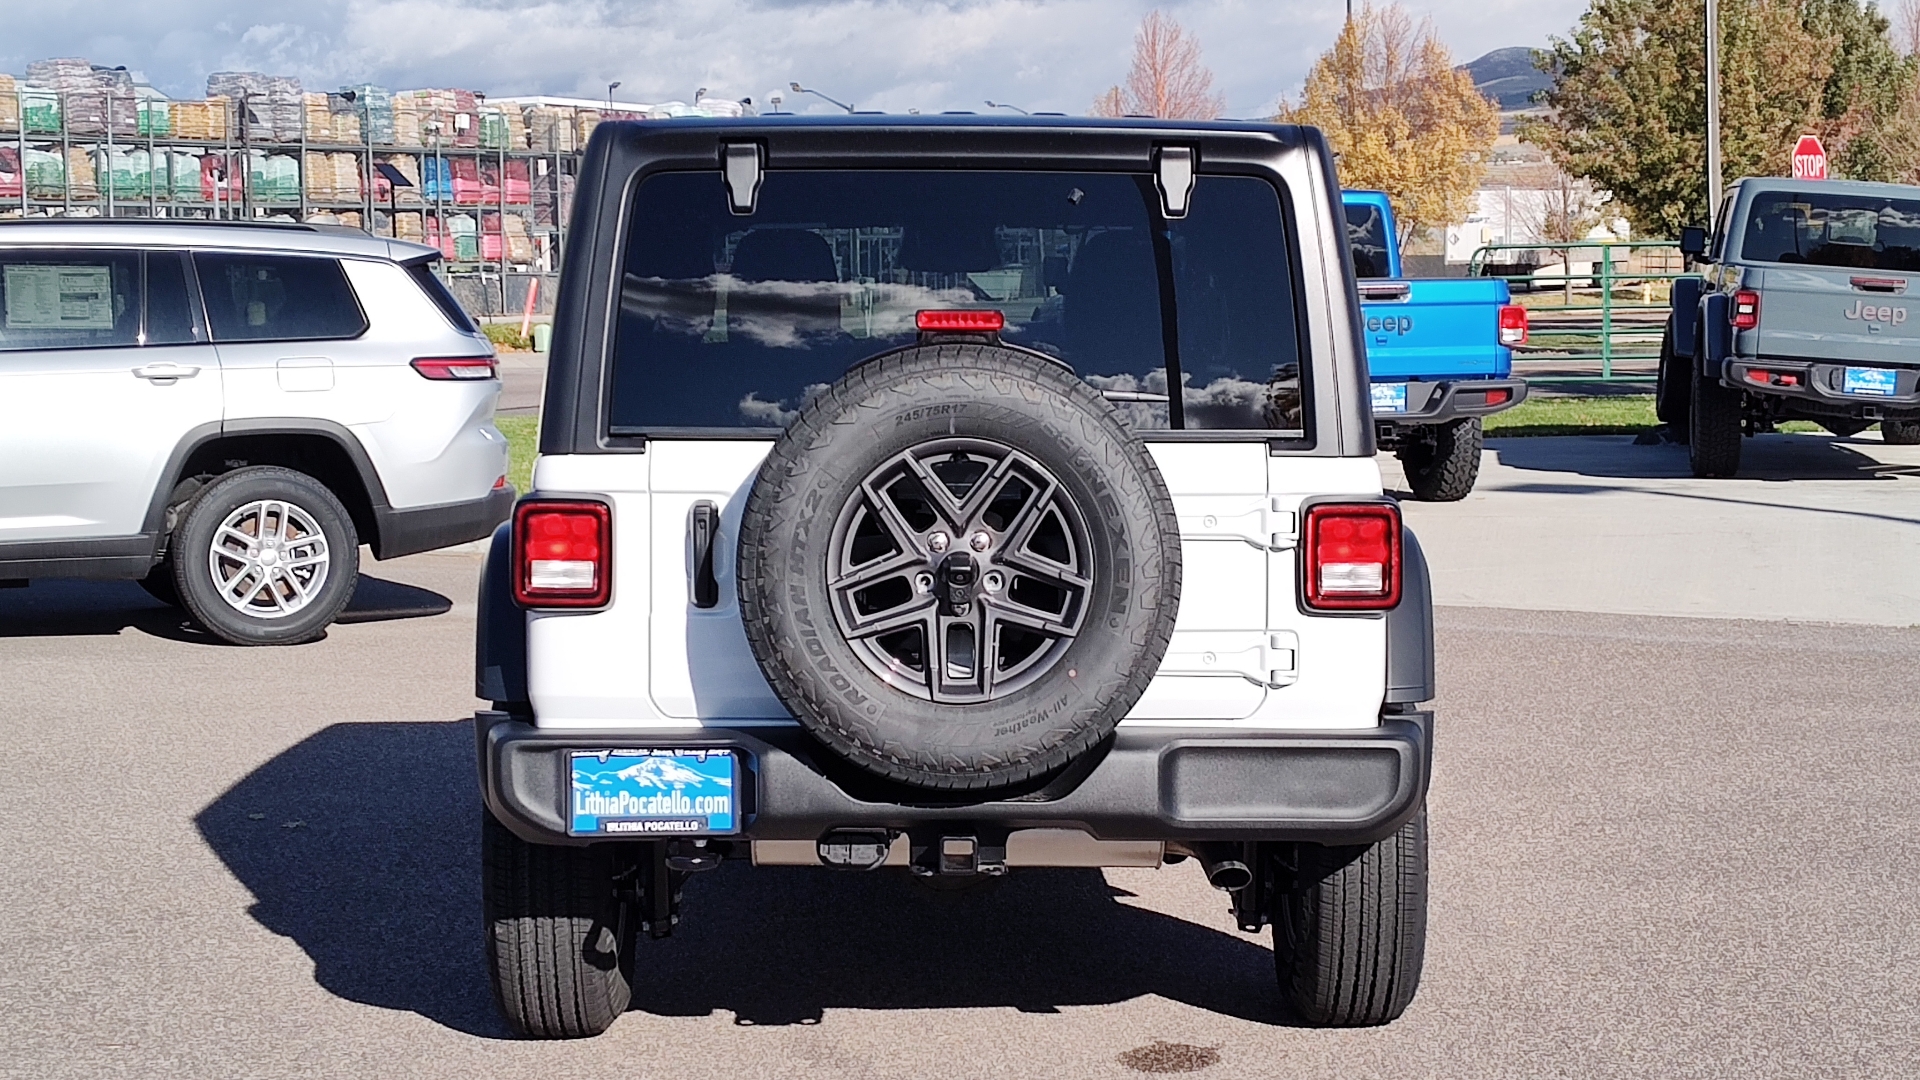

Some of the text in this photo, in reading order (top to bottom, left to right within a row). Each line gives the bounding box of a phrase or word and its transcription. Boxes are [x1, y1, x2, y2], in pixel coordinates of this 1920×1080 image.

[1795, 154, 1824, 177] STOP
[1844, 300, 1907, 327] Jeep
[895, 403, 968, 427] 245/75R17
[1081, 465, 1131, 614] NEXEN
[789, 488, 869, 706] ROADIAN HTX2
[994, 693, 1068, 737] All-Weather
[576, 790, 729, 815] LithiaPocatello.com
[645, 820, 699, 832] POCATELLO
